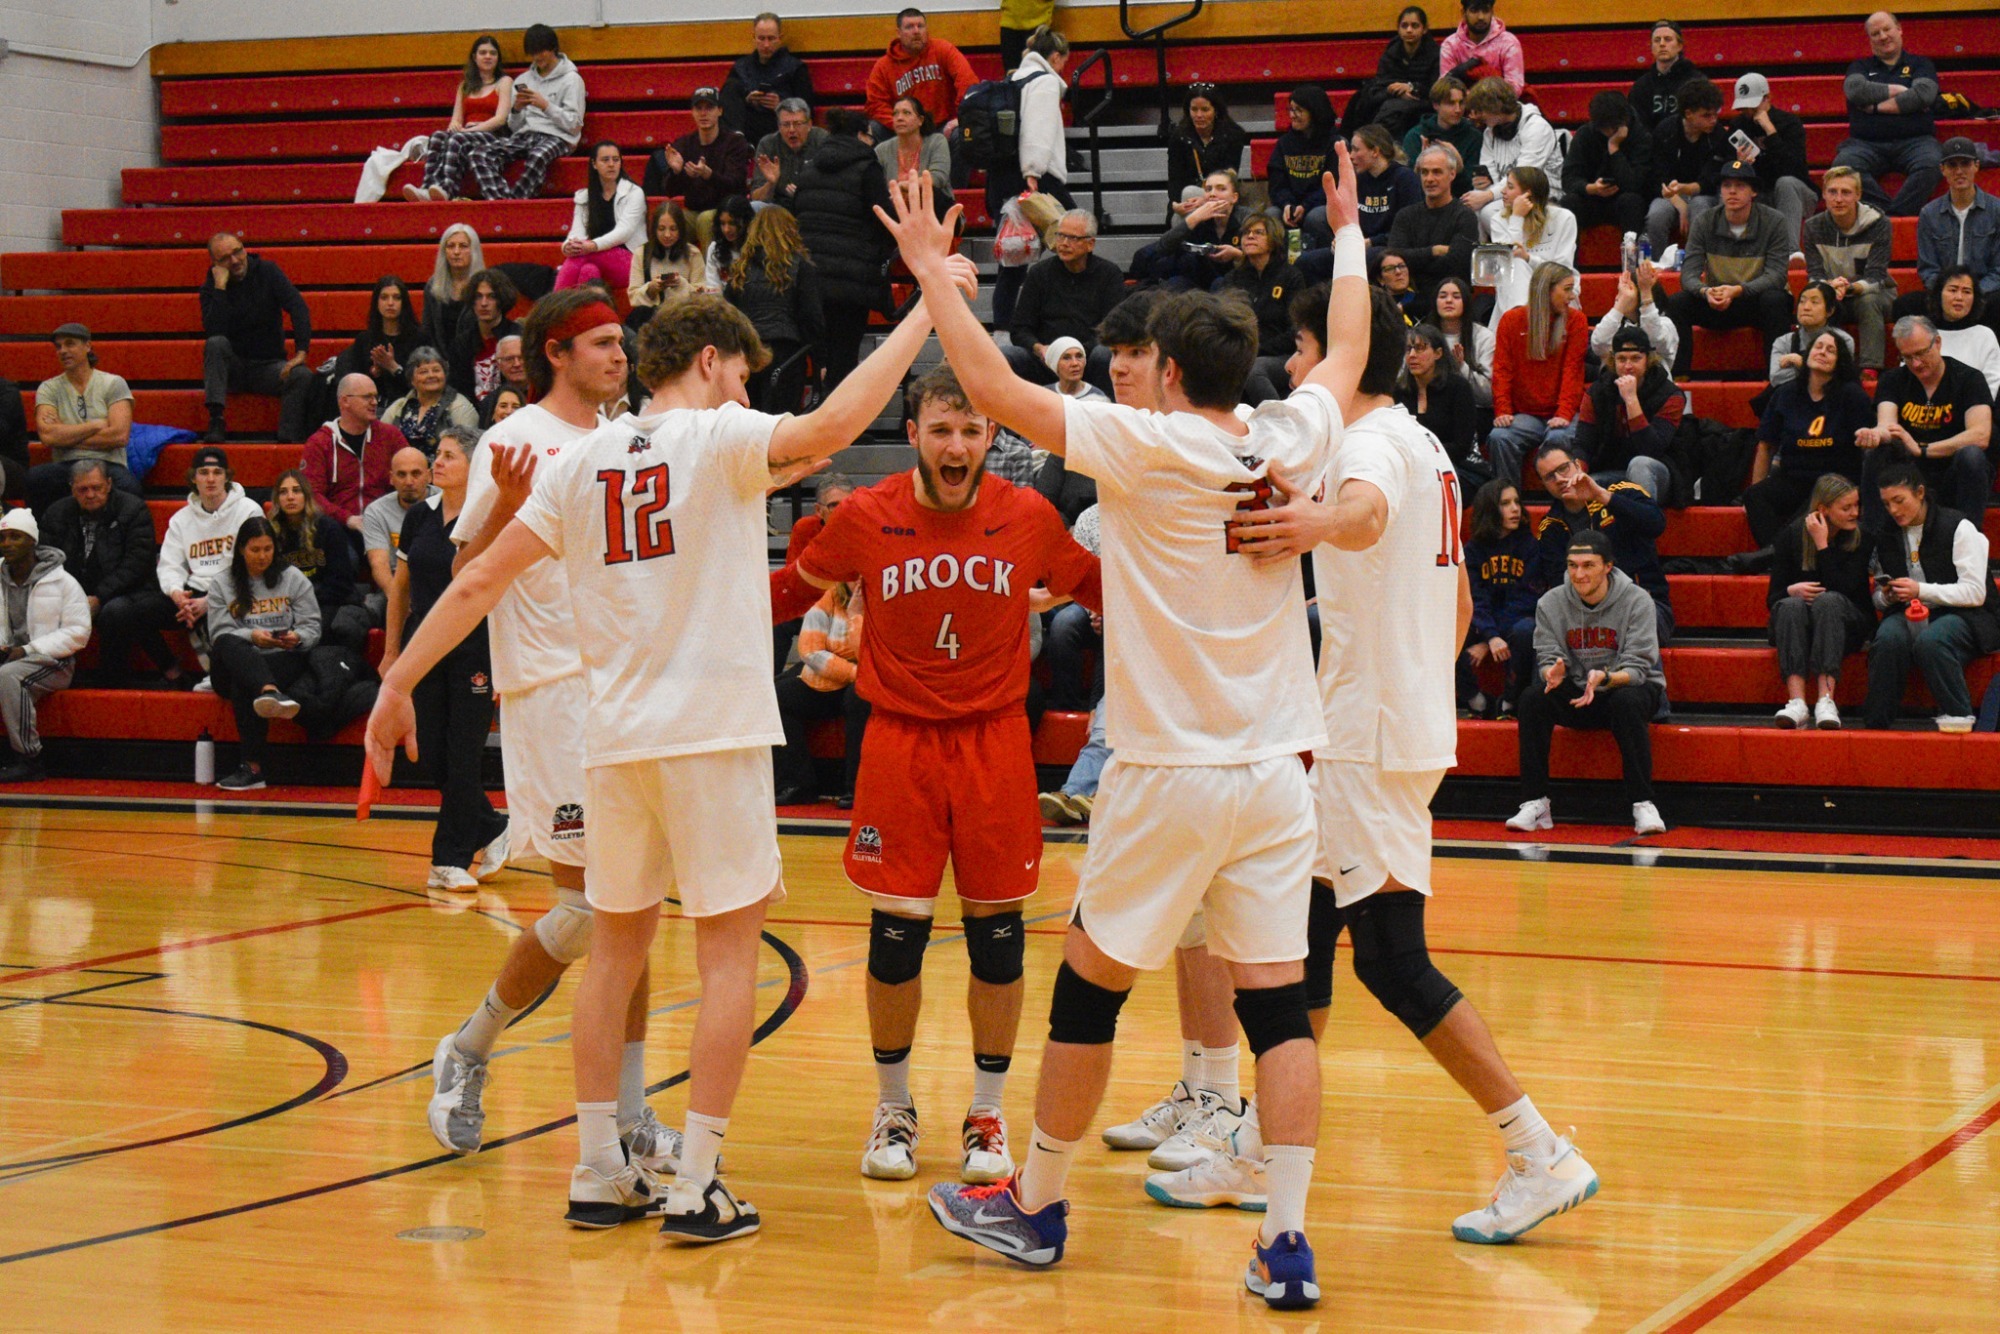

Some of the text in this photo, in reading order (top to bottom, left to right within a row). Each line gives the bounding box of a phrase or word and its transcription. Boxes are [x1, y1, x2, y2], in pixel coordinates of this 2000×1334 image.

[913, 64, 942, 84] STATE
[596, 462, 676, 566] 12
[881, 553, 1016, 602] BROCK
[934, 612, 962, 661] 4
[550, 831, 586, 841] VOLLEYBA
